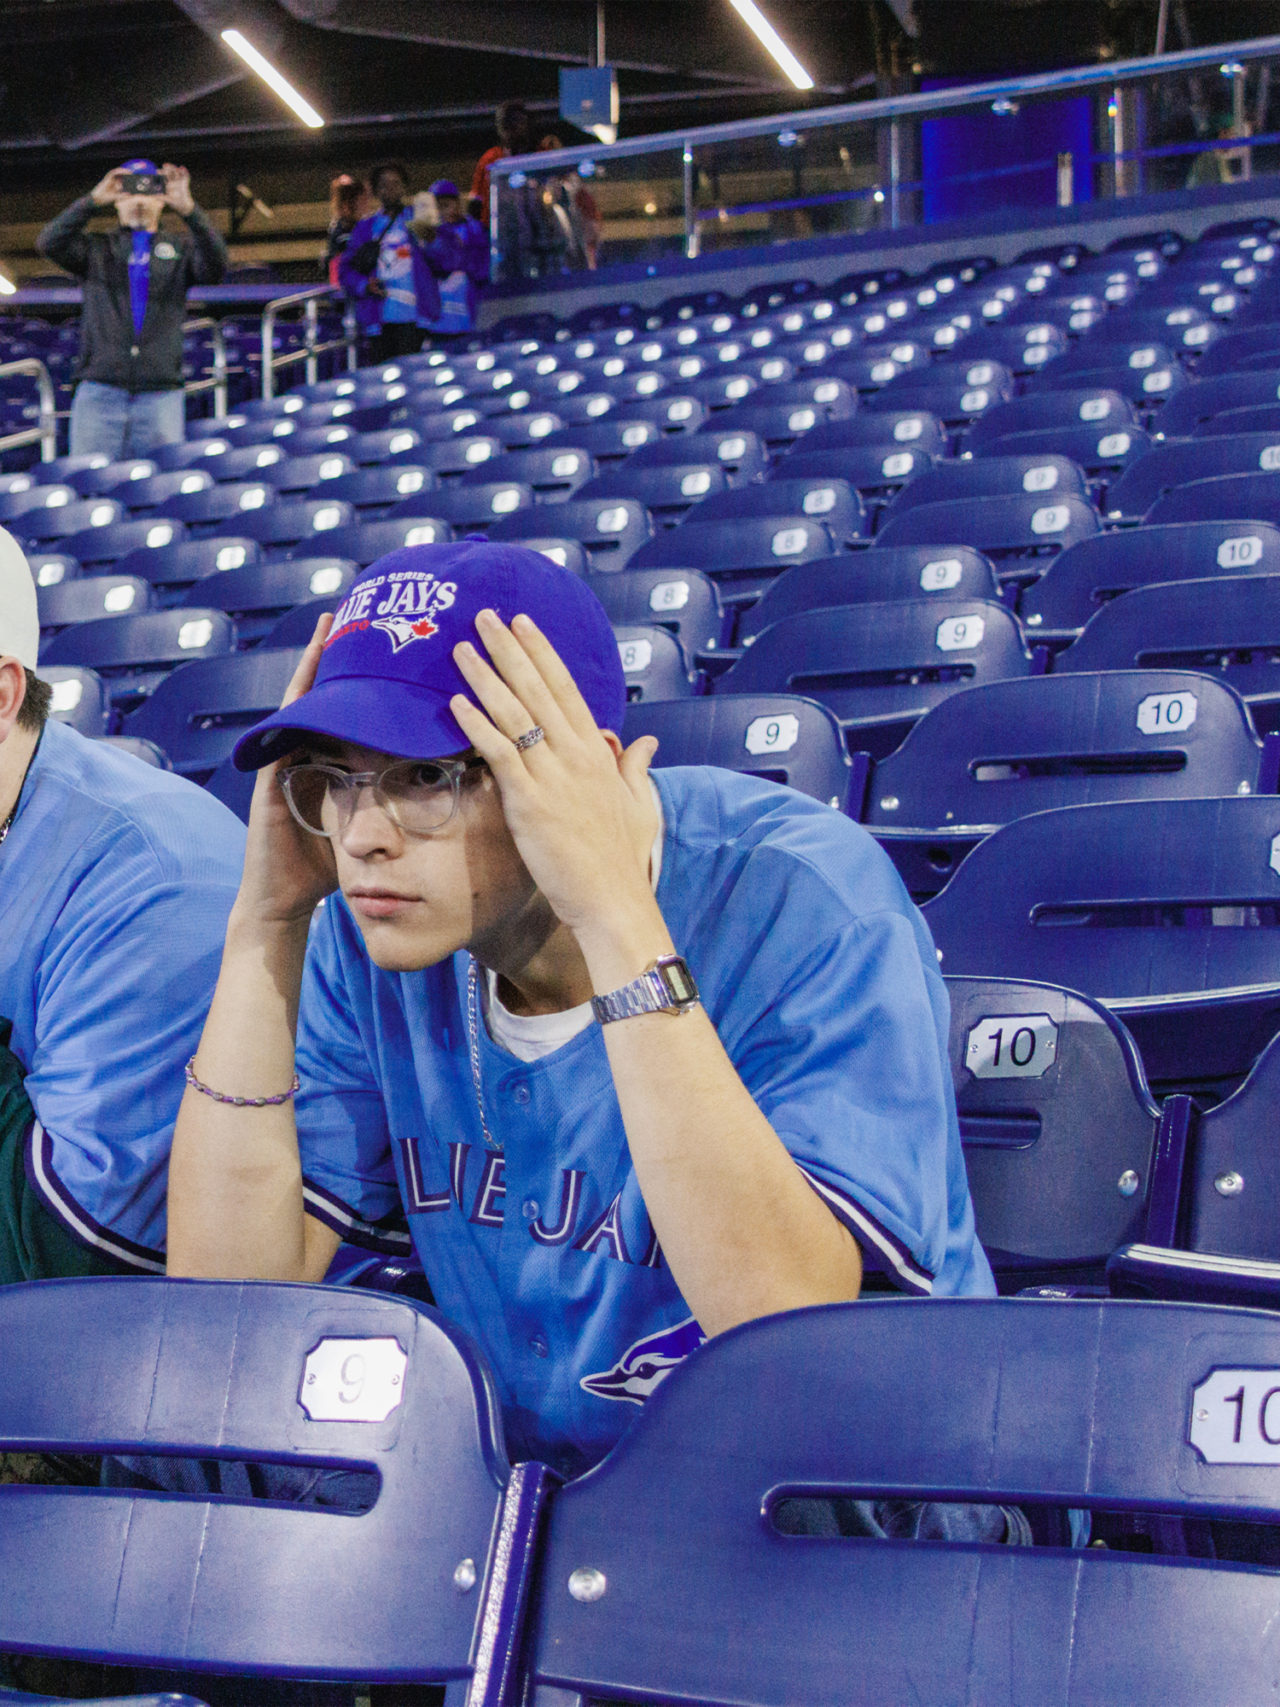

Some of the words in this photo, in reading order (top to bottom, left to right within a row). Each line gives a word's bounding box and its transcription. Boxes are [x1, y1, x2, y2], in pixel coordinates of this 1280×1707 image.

[1045, 511, 1057, 528] 9
[1228, 541, 1252, 562] 10
[387, 571, 435, 584] SERIES
[936, 565, 949, 584] 9
[376, 581, 458, 616] JAYS
[663, 587, 675, 605] 8
[953, 622, 968, 644] 9
[623, 646, 636, 667] 8
[1151, 699, 1184, 727] 10
[765, 722, 781, 746] 9
[987, 1026, 1037, 1068] 10
[337, 1353, 367, 1404] 9
[1223, 1386, 1280, 1445] 10
